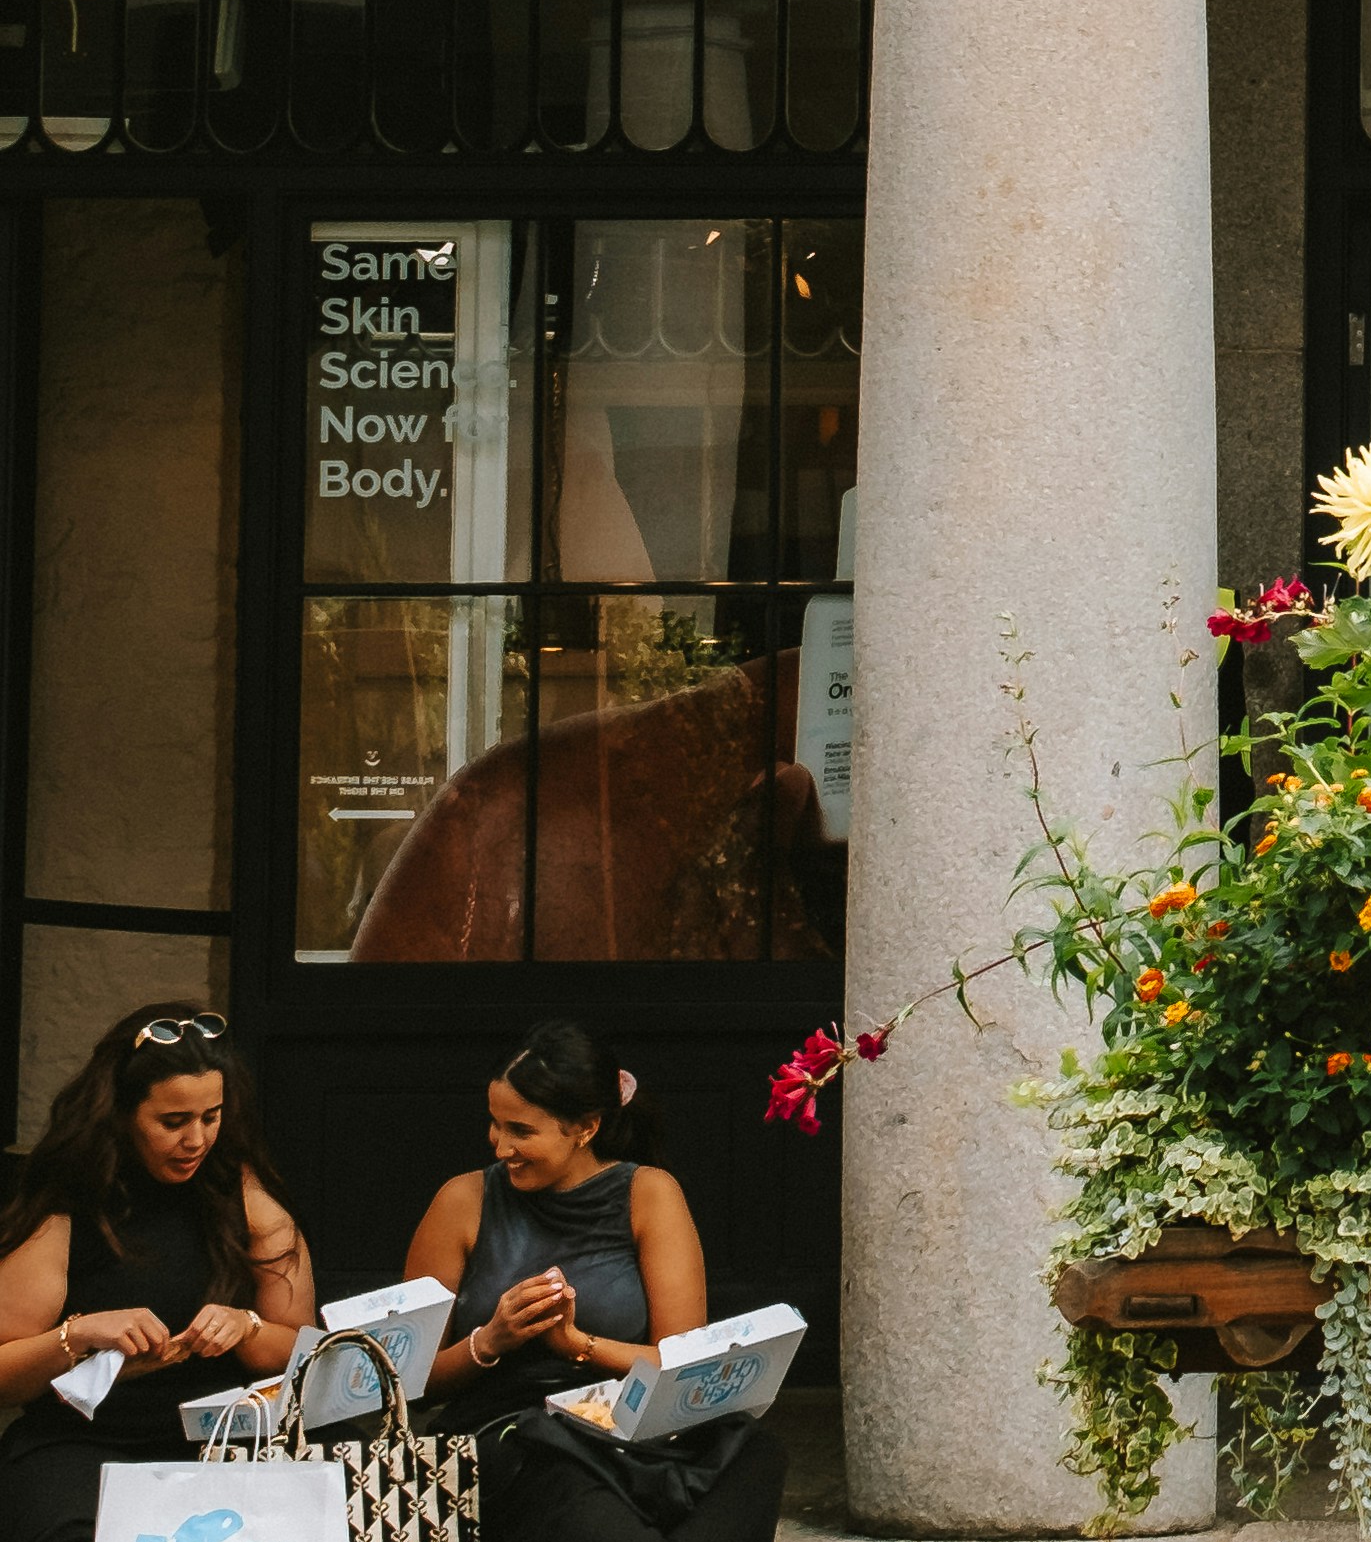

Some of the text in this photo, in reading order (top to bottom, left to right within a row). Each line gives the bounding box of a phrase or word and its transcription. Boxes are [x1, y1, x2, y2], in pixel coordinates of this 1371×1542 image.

[321, 242, 458, 281] Same
[320, 296, 421, 336] Skin
[320, 405, 428, 444] Now
[319, 458, 448, 509] Body.
